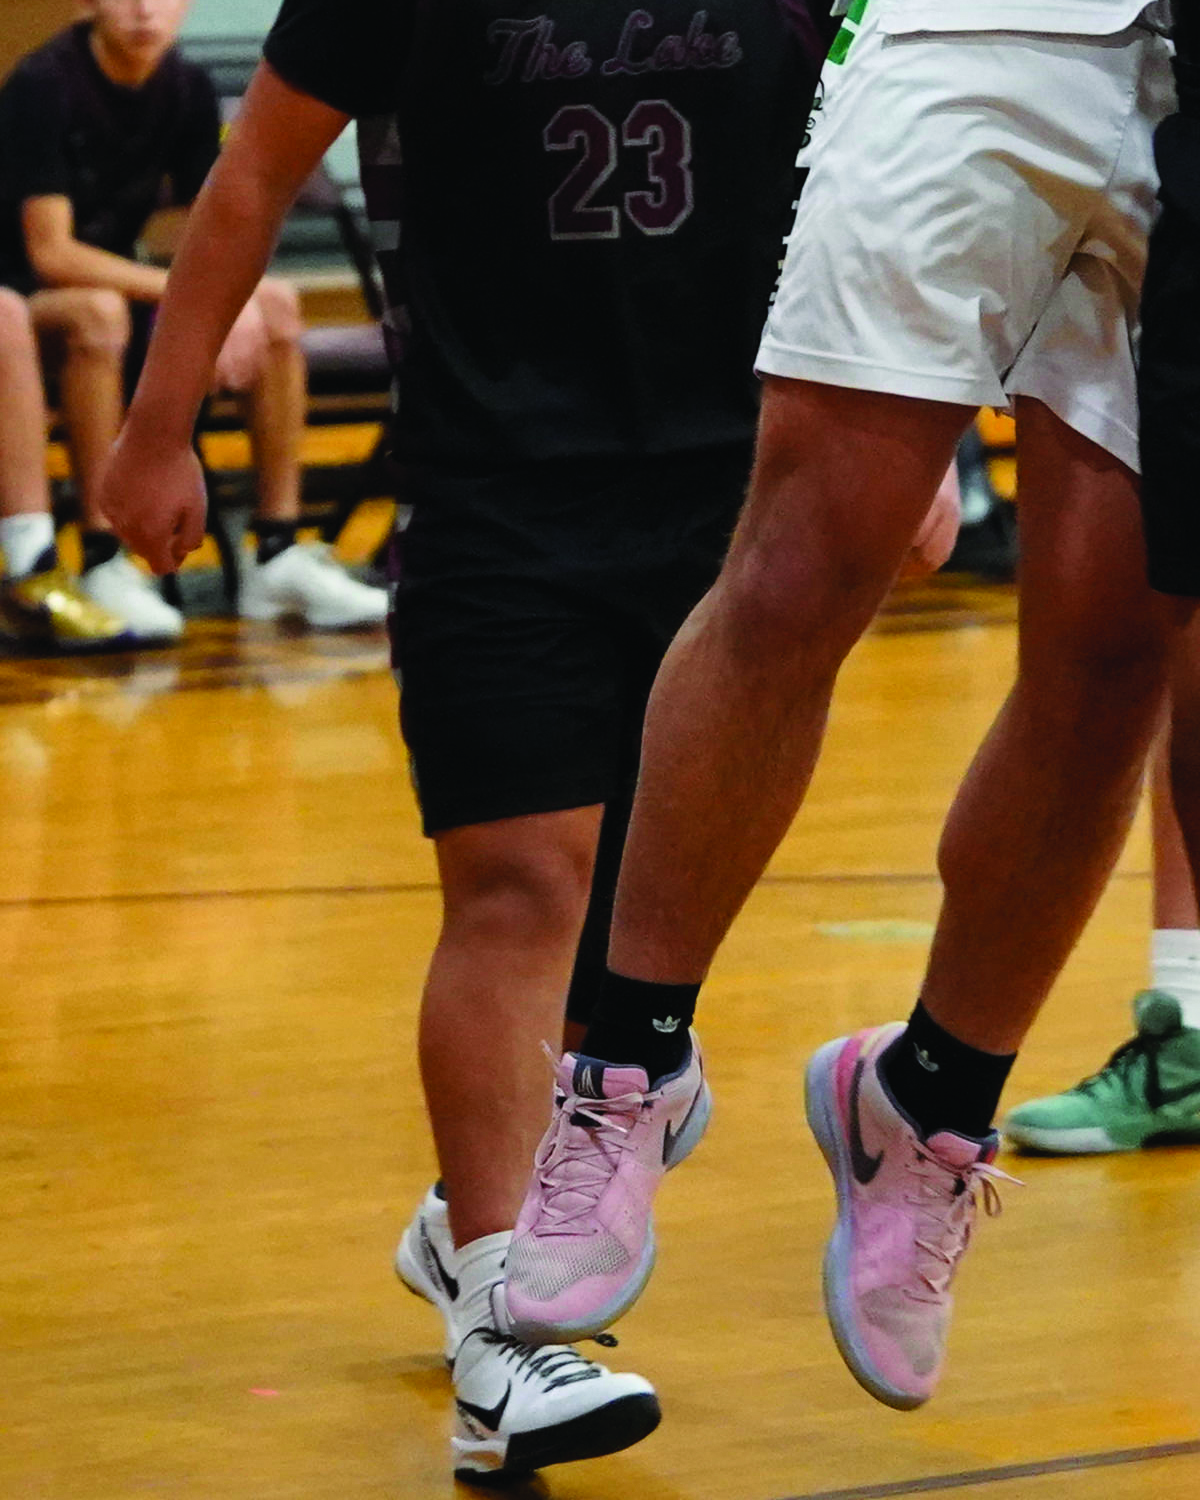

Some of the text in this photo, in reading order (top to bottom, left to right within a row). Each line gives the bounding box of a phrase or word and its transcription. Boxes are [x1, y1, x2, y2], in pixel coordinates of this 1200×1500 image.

[483, 8, 743, 86] The Lake
[542, 99, 695, 241] 23
